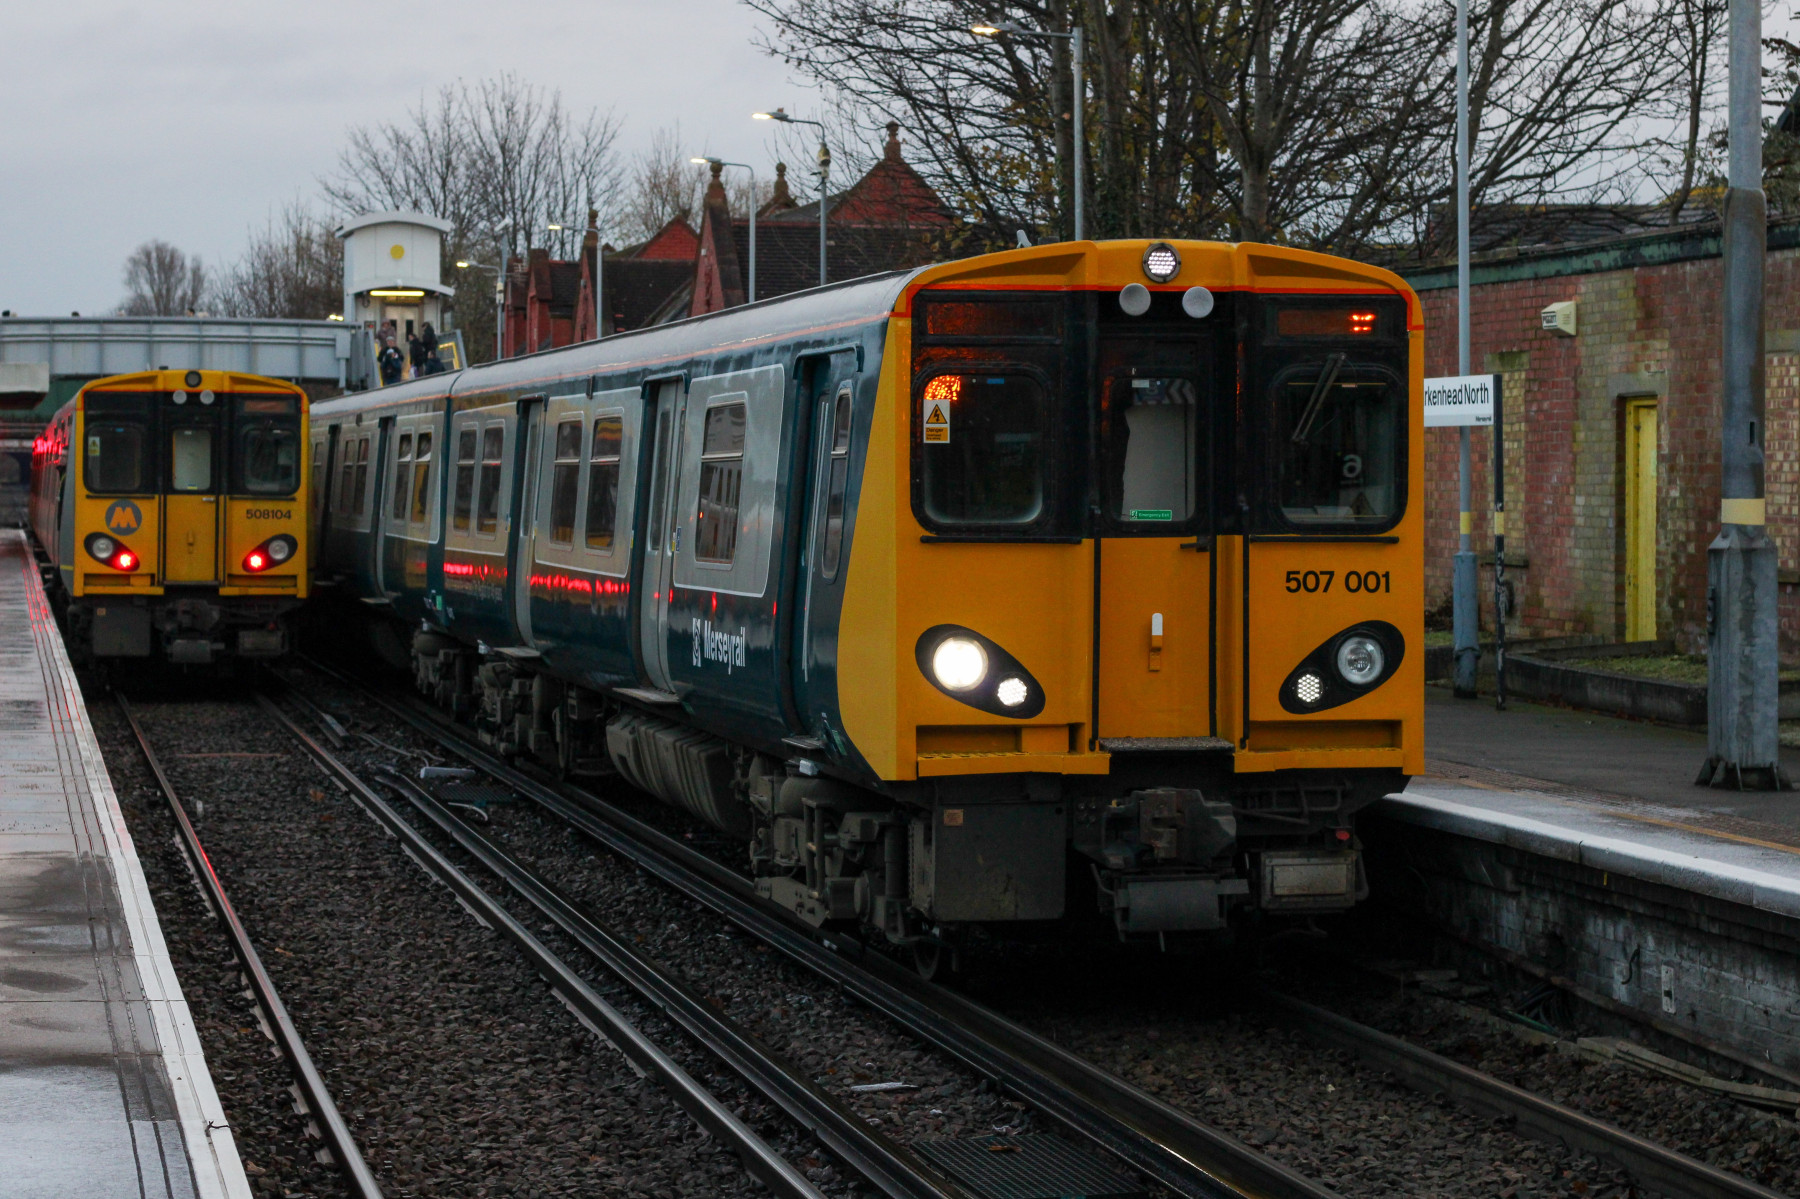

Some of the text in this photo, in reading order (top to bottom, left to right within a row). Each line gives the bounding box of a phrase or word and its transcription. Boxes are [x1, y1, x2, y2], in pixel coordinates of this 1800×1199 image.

[1424, 382, 1489, 406] rkenhead North
[246, 509, 292, 519] 508104
[1285, 570, 1391, 594] 507 001
[704, 620, 746, 675] Merseyrail
